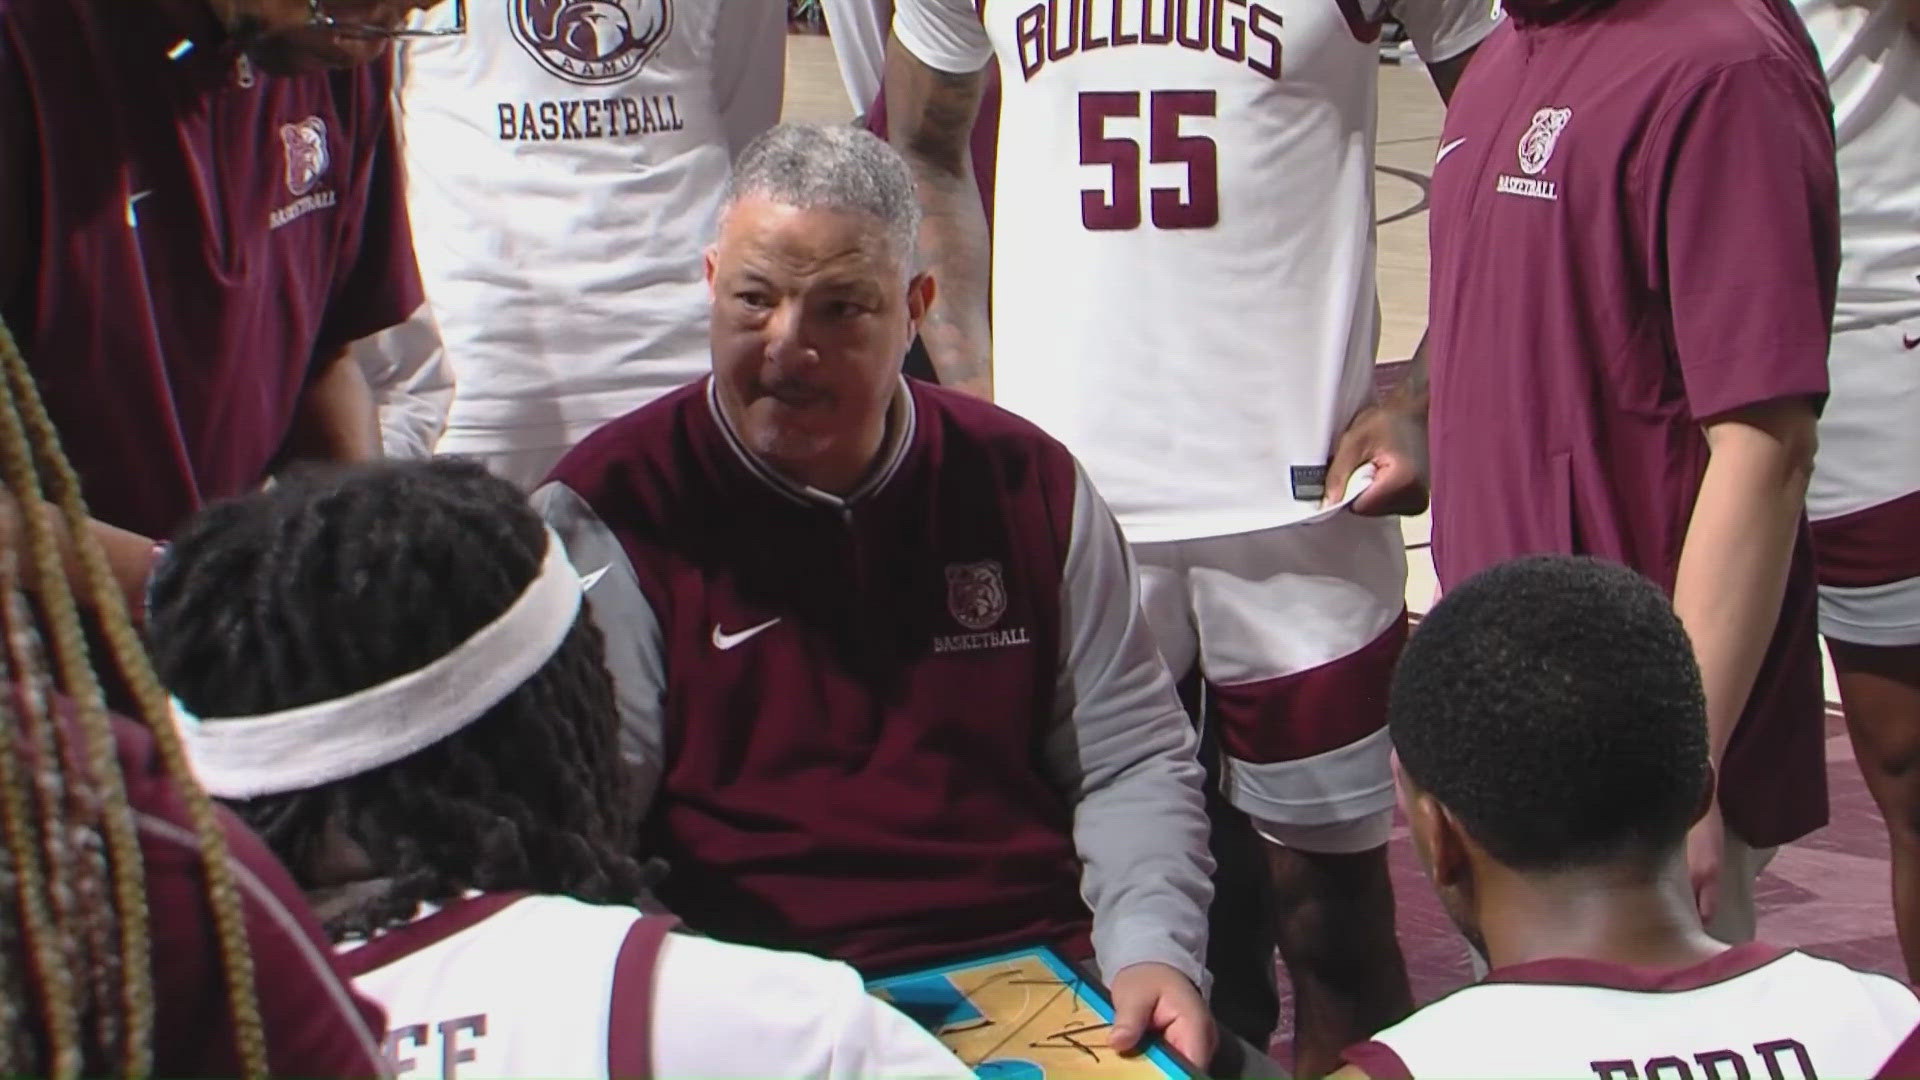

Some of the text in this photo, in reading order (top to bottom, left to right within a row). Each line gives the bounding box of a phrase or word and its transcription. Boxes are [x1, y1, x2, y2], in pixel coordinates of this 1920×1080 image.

[560, 54, 634, 77] AAMU
[498, 95, 684, 140] BASKETBALL
[1078, 89, 1219, 231] 55
[933, 627, 1030, 653] BASKETBALL
